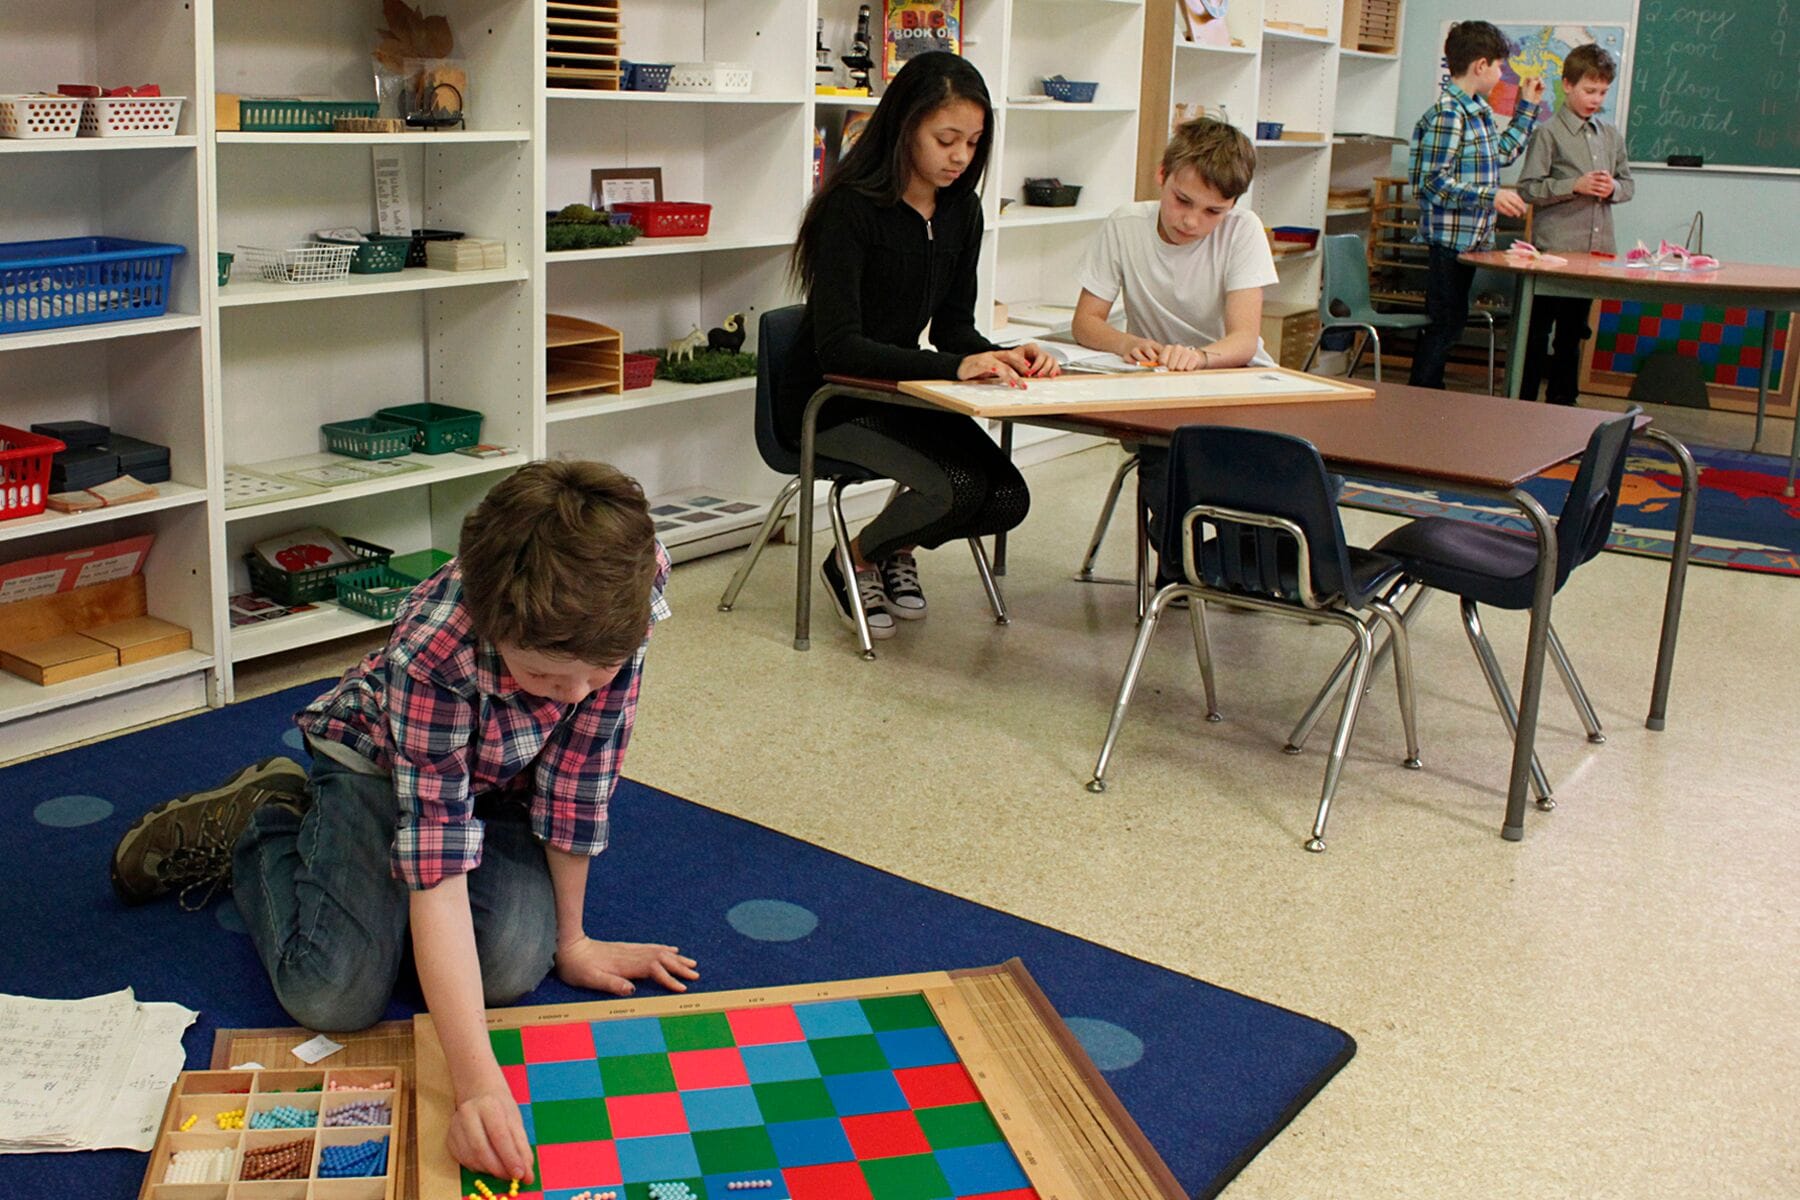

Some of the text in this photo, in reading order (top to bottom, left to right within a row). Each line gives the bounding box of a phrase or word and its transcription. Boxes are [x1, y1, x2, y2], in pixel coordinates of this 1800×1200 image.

[901, 10, 945, 29] BIG
[1666, 7, 1736, 41] copy
[894, 27, 933, 39] BOOK
[1664, 41, 1725, 66] poor
